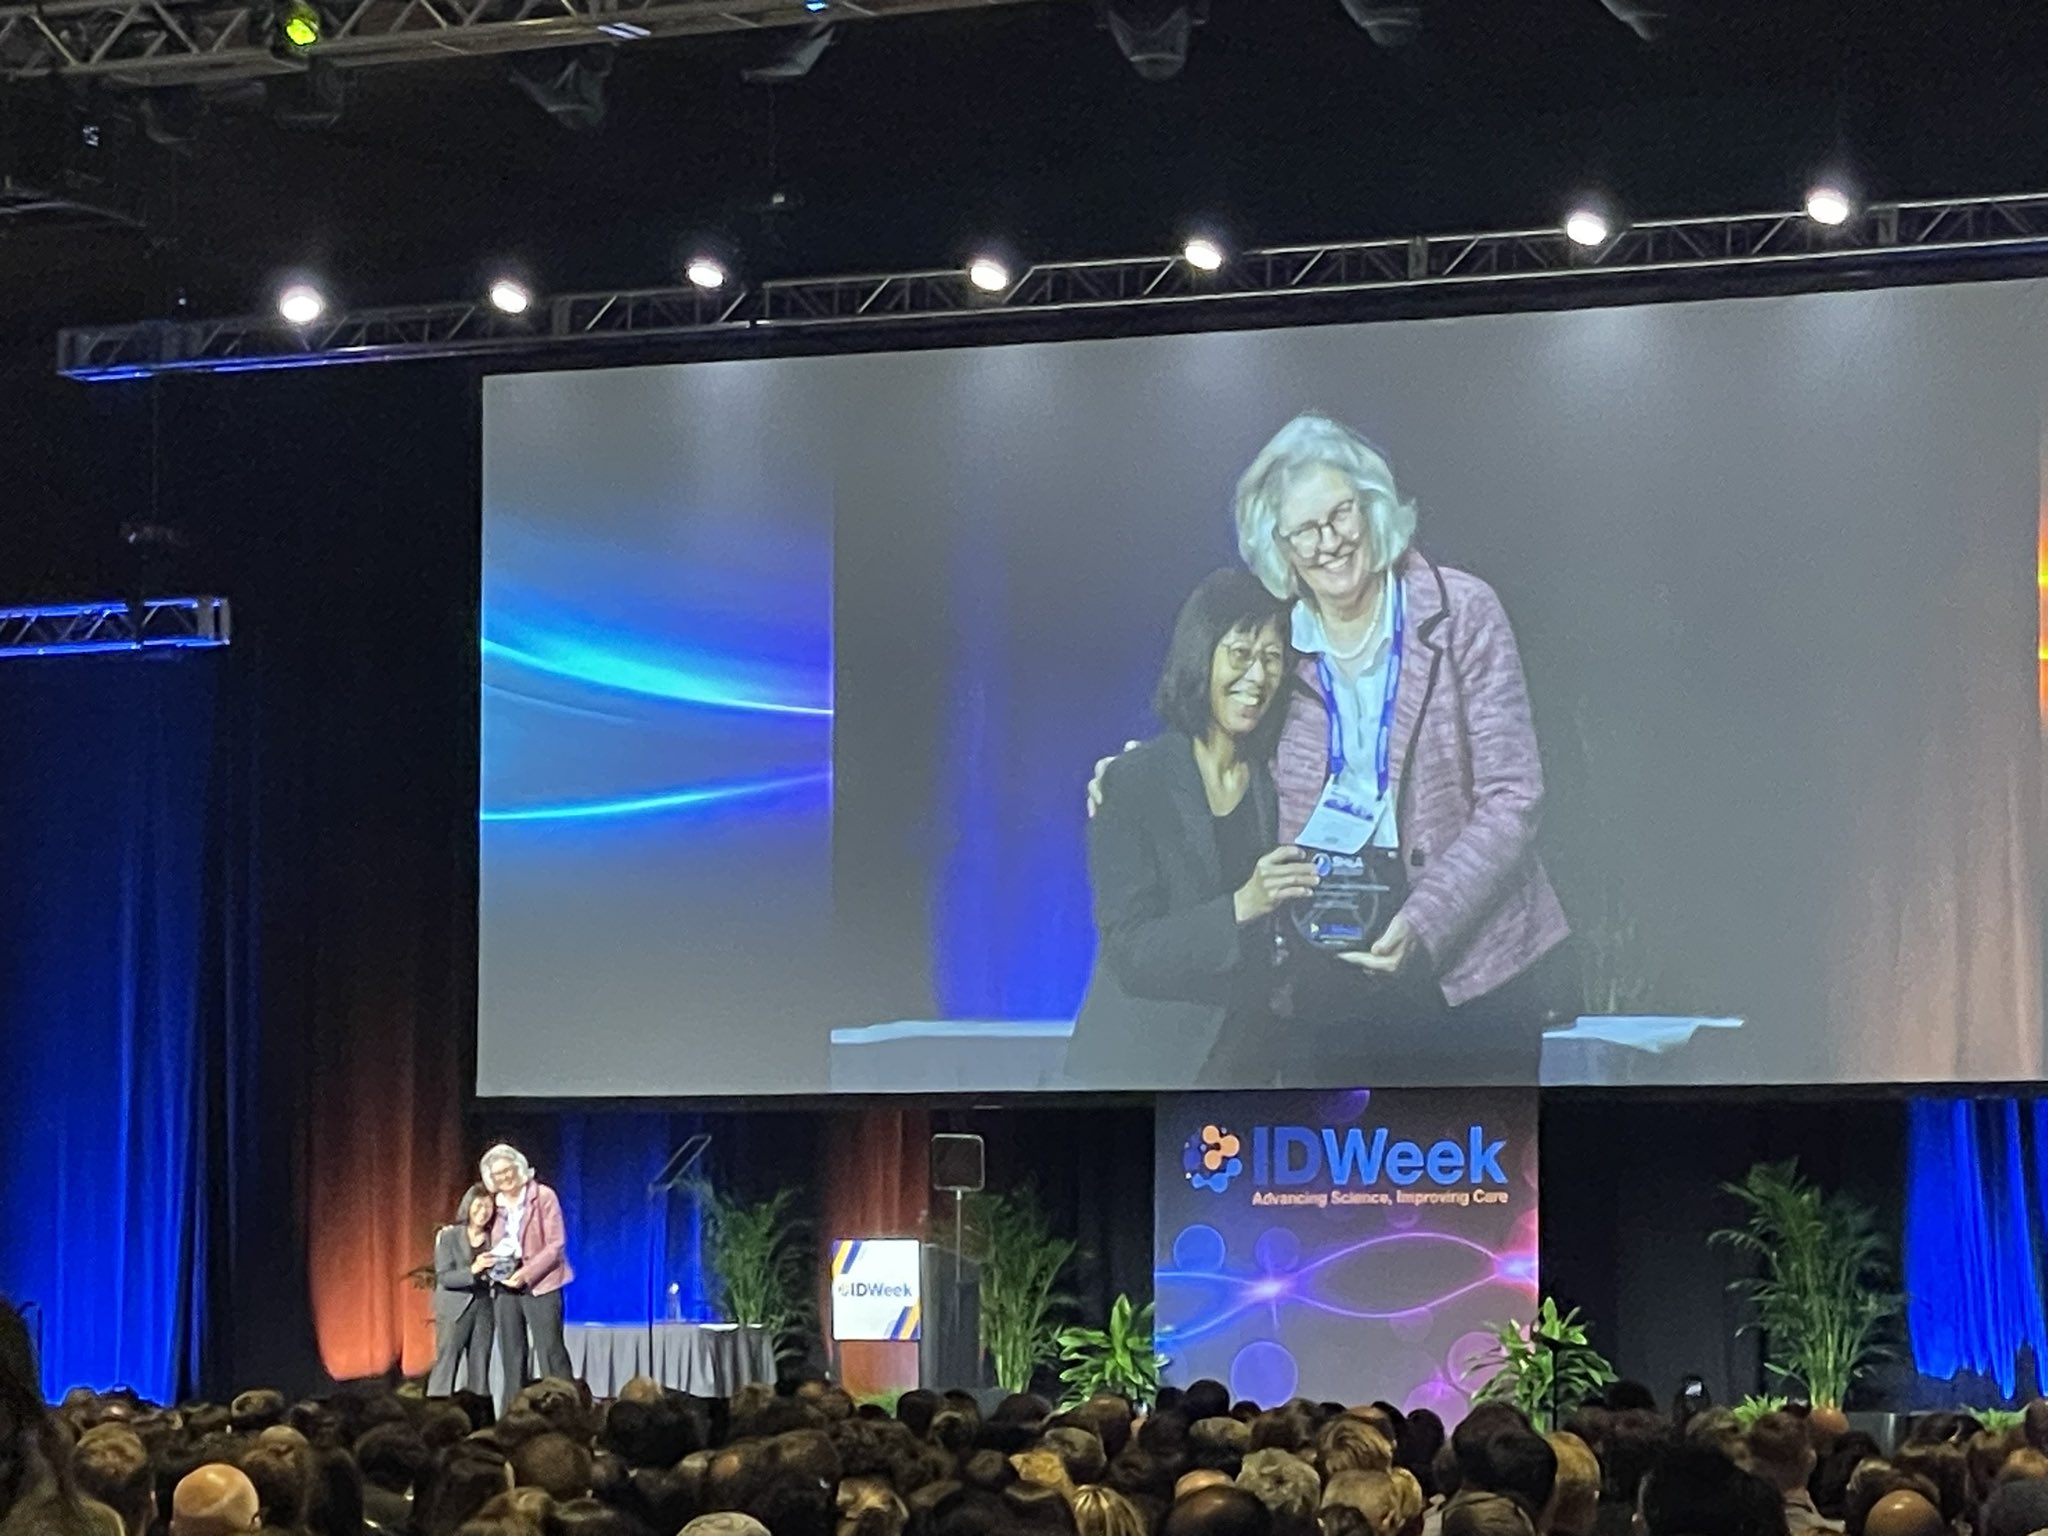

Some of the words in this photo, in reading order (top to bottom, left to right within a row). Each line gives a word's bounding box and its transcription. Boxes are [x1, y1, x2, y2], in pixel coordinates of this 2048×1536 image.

[1252, 1126, 1508, 1185] IDWeek
[1252, 1191, 1328, 1207] Advancing
[1331, 1191, 1392, 1206] Science,
[1396, 1190, 1470, 1206] Improving
[1473, 1189, 1509, 1203] Care
[851, 1282, 912, 1297] IDWeek
